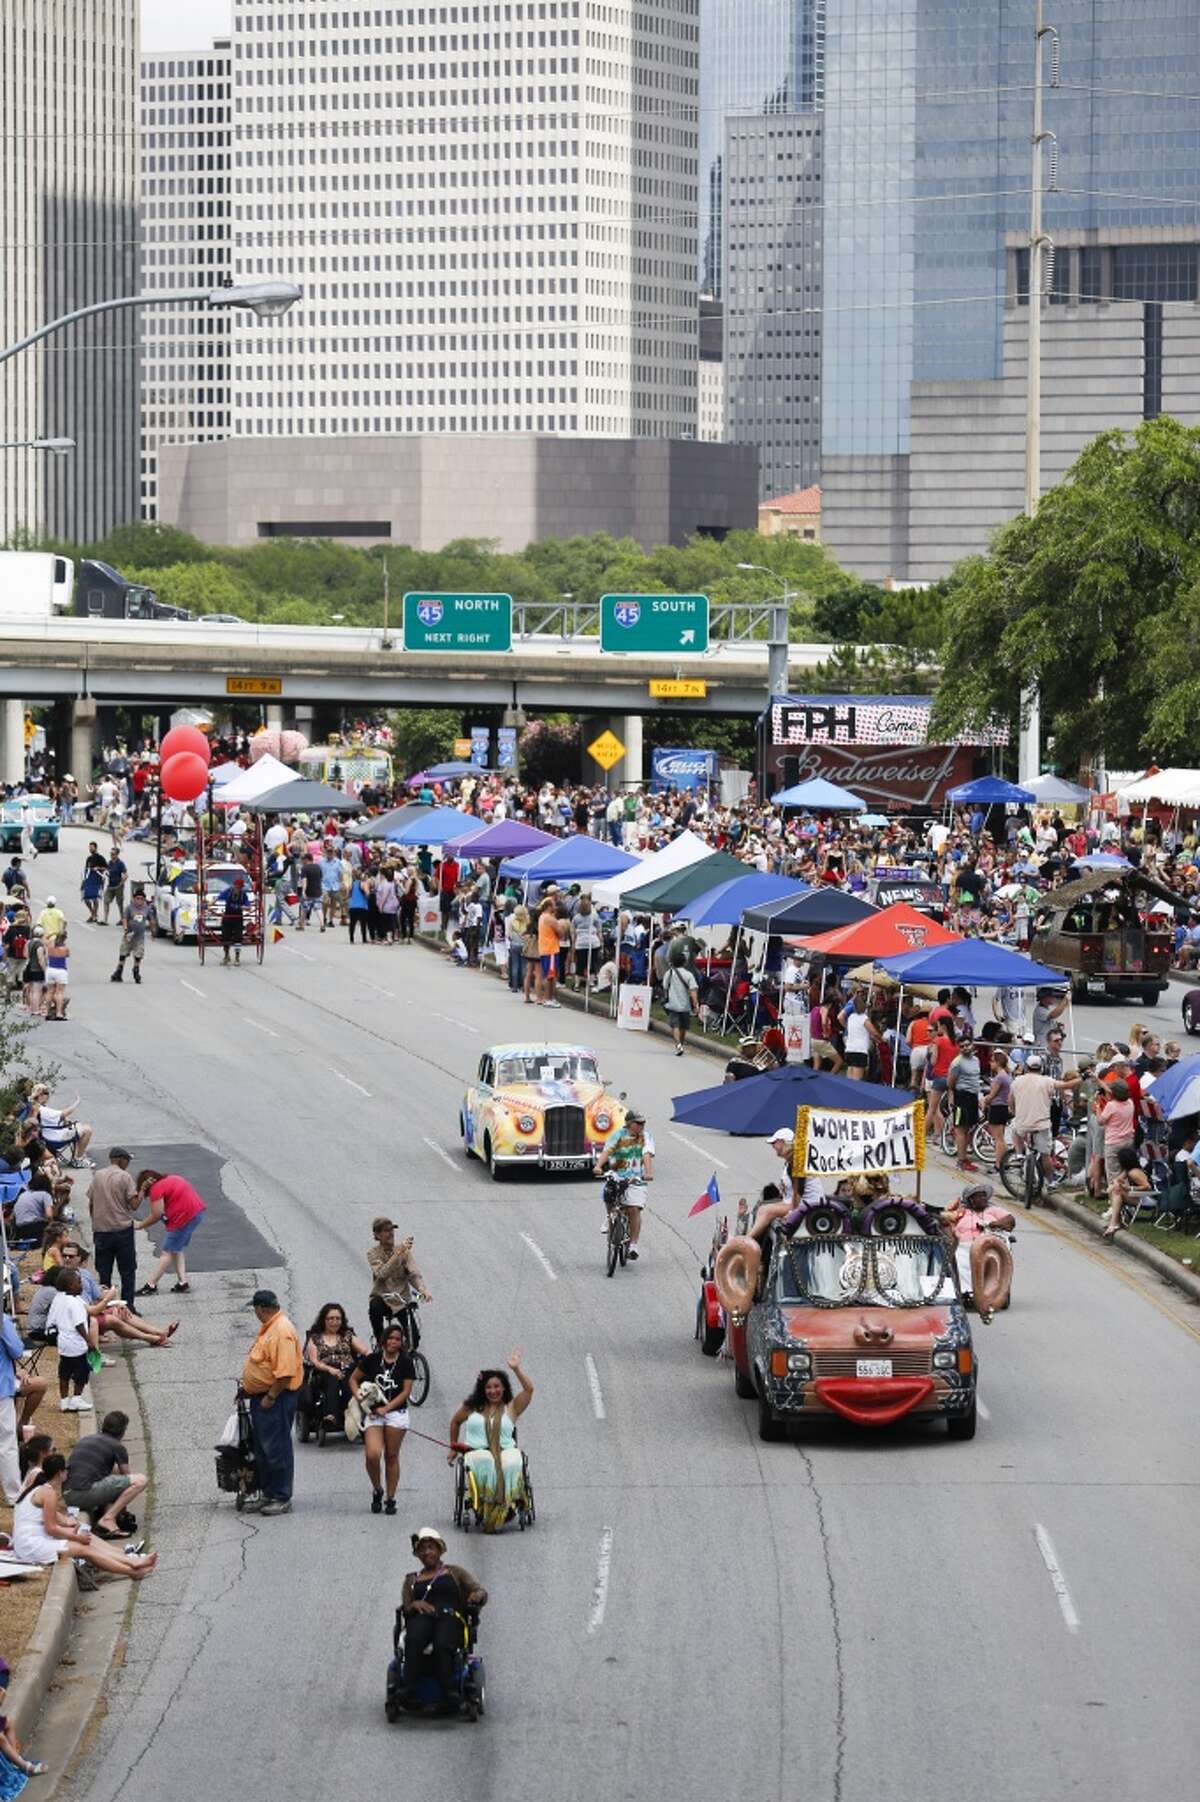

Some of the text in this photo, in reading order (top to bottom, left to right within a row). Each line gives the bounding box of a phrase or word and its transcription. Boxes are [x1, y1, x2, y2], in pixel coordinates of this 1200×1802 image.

[420, 606, 442, 620] 45
[454, 600, 500, 611] NORTH
[651, 601, 696, 612] SOUTH
[616, 607, 639, 622] 45
[424, 633, 491, 643] NEXT RIGHT
[781, 706, 919, 740] FPH Come
[776, 754, 954, 784] Budweiser
[812, 1111, 913, 1141] WOMEN That
[863, 1136, 914, 1169] ROLL
